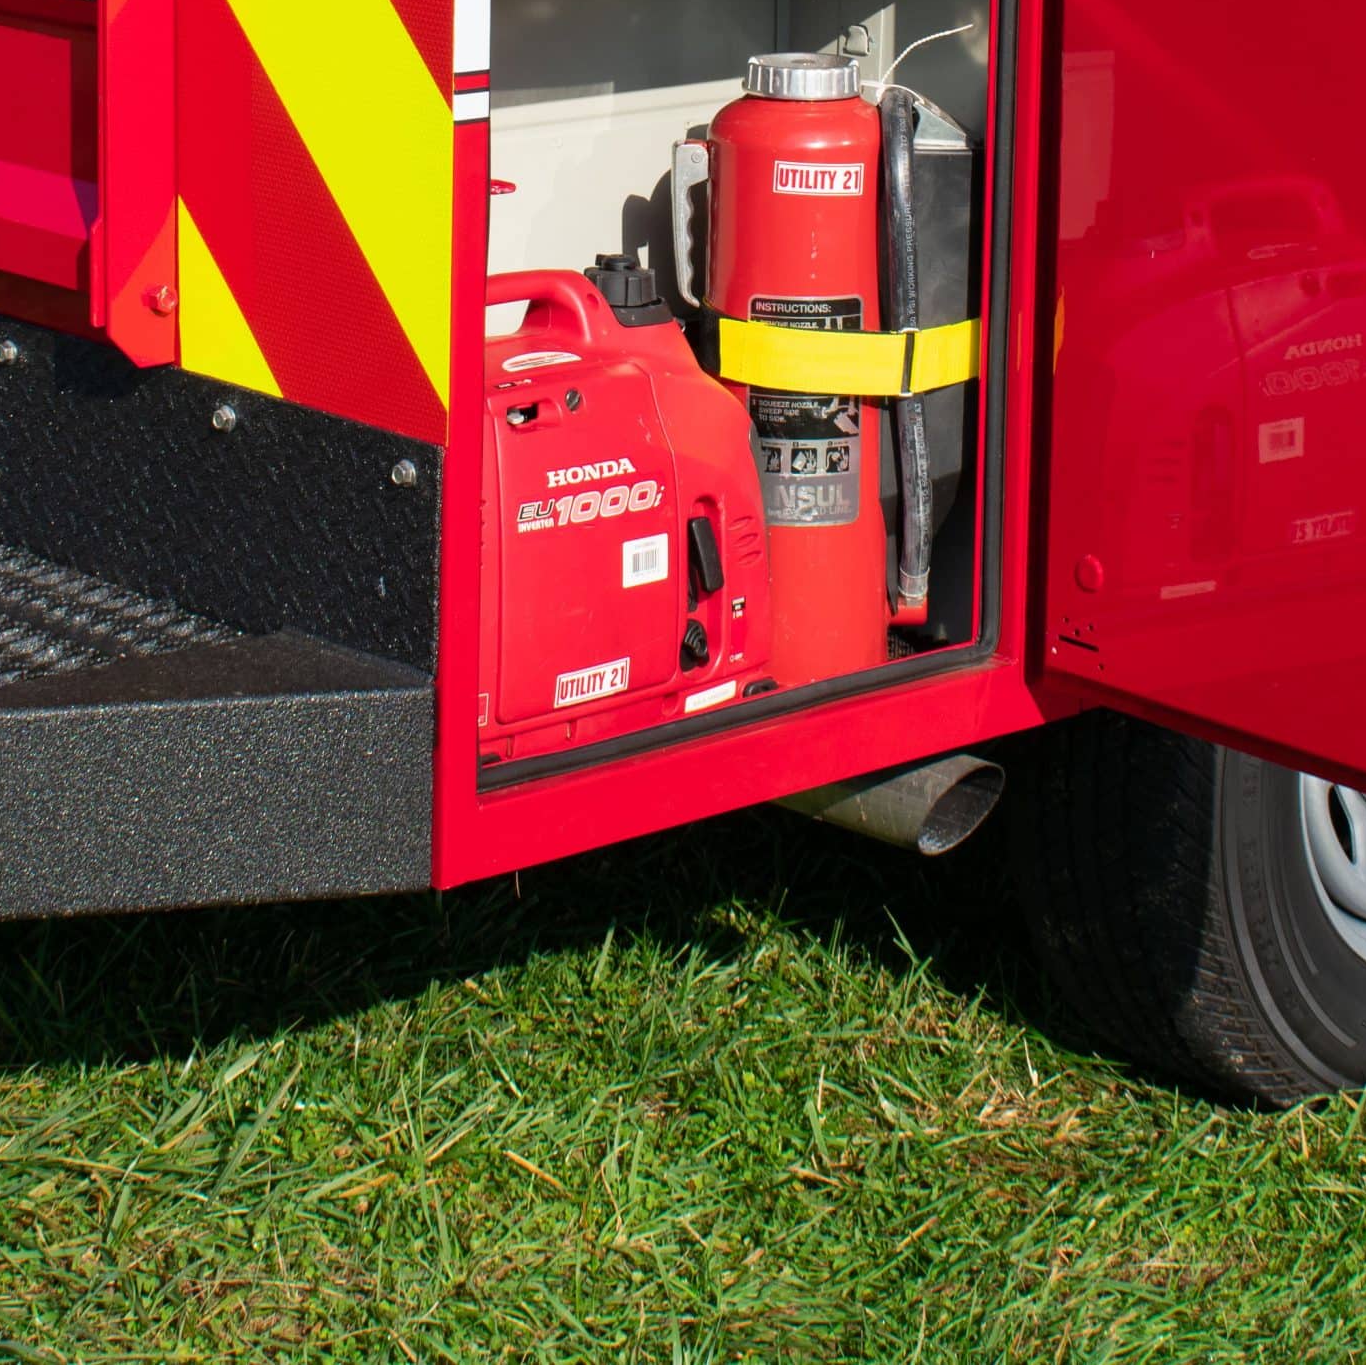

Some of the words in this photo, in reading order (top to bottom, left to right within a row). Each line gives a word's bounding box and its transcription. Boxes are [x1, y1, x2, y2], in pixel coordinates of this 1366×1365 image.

[779, 168, 837, 190] UTILITY
[842, 170, 859, 190] 21
[904, 201, 915, 252] PRESSURE
[906, 255, 916, 300] WORKING
[755, 301, 832, 314] INSTRUCTIONS:
[547, 458, 636, 488] HONDA
[776, 484, 850, 507] NSUL
[518, 517, 555, 533] INVERTER
[560, 670, 606, 700] UTILITY
[610, 666, 625, 687] 21
